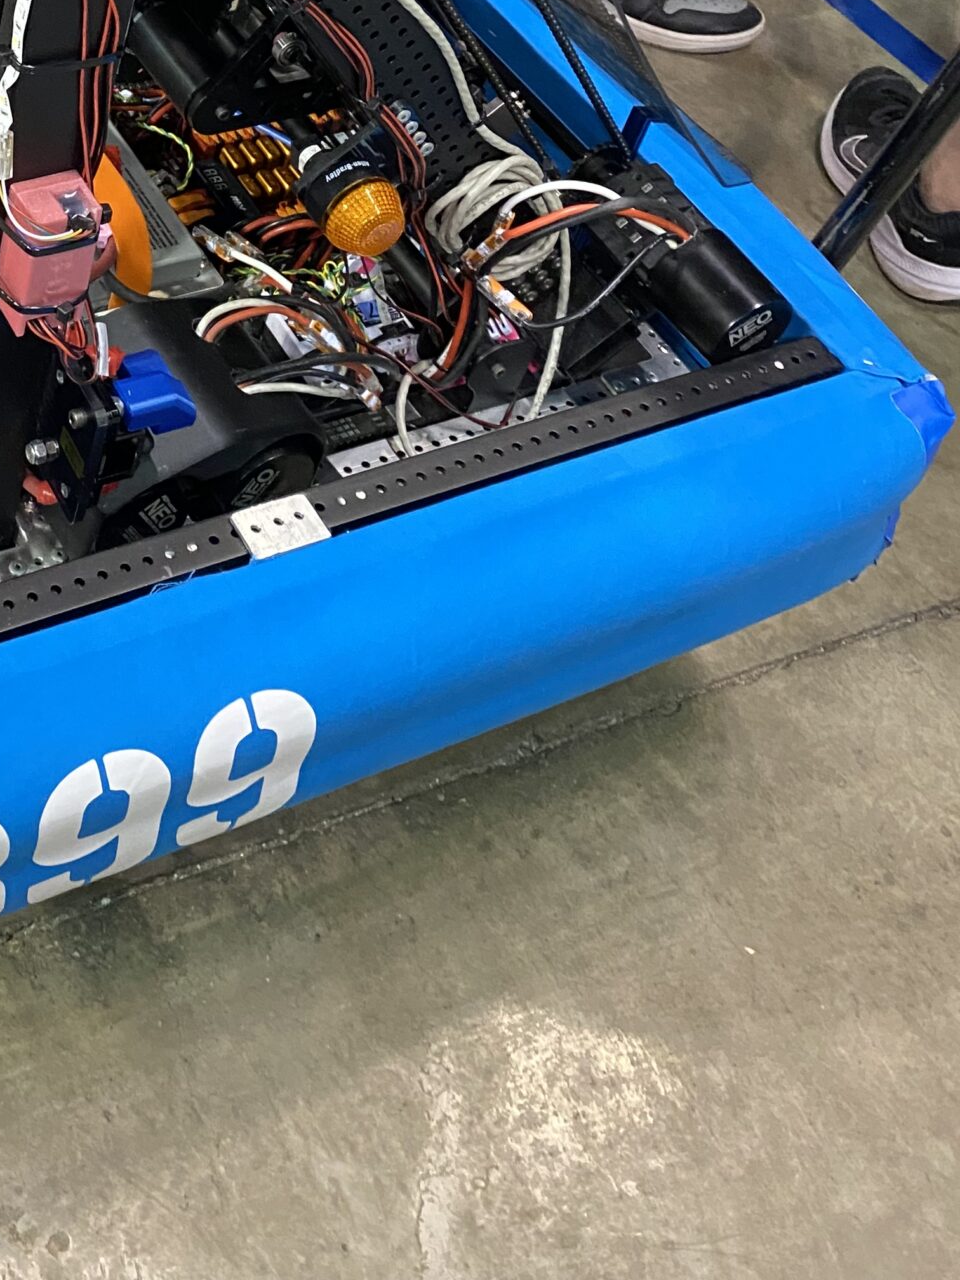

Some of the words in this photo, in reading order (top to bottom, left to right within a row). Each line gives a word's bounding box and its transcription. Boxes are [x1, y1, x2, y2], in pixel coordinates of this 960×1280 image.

[729, 309, 773, 348] NEO
[232, 469, 275, 507] NEO
[144, 497, 177, 529] NEO
